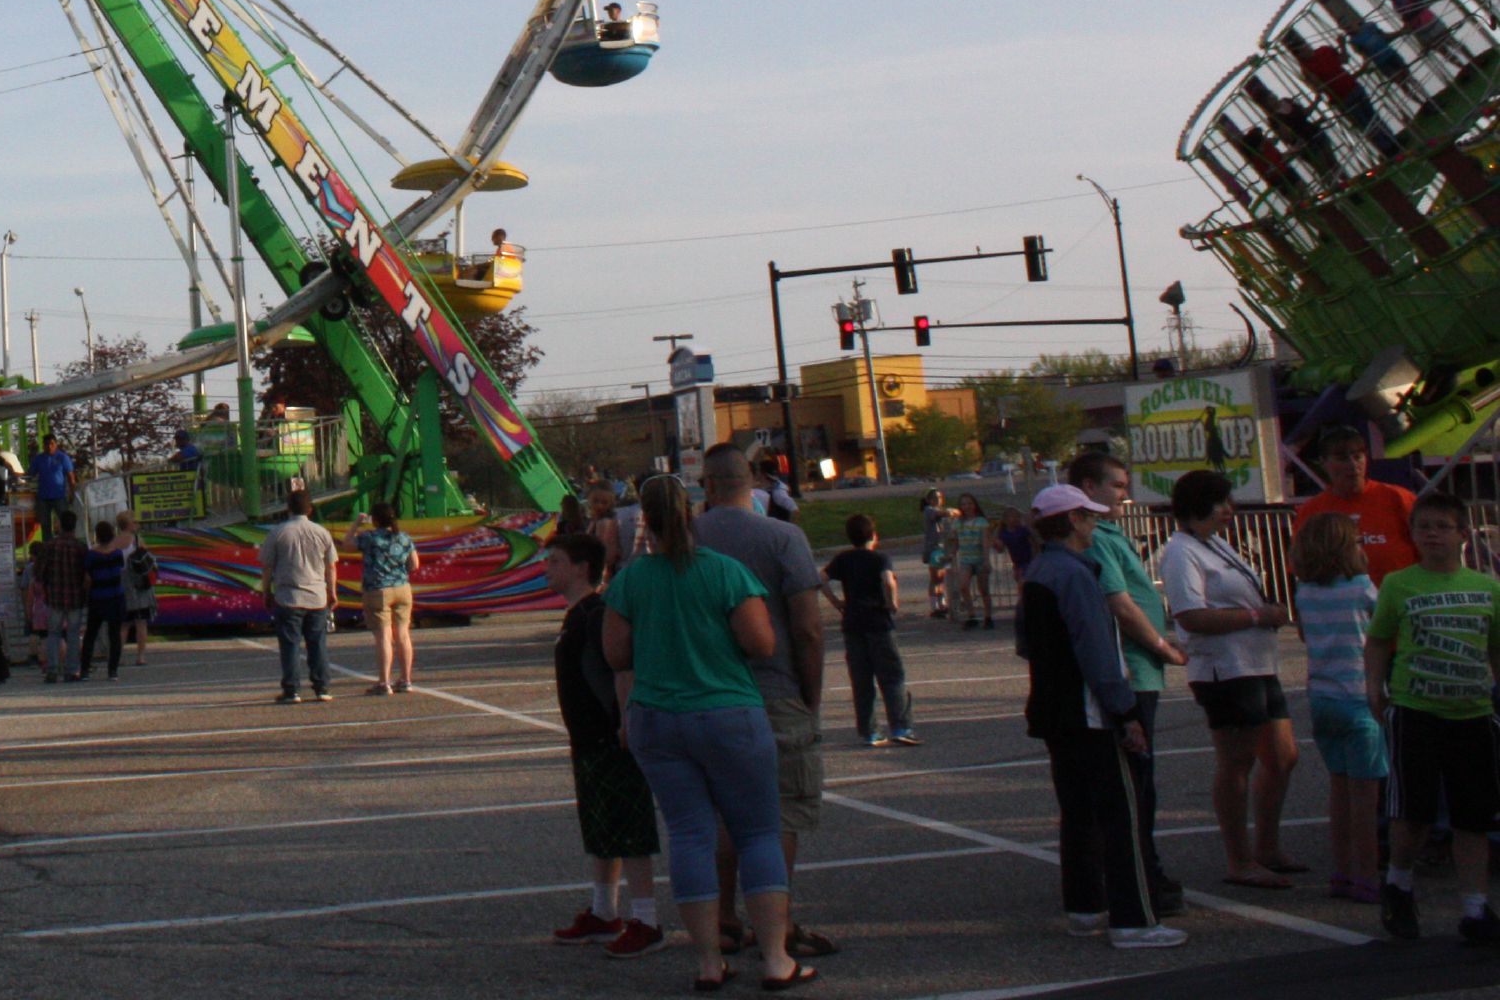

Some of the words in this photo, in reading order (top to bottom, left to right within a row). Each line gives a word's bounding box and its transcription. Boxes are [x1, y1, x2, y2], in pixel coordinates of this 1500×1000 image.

[1140, 377, 1238, 421] ROCKWELL
[1129, 420, 1207, 464] ROUND
[1217, 415, 1255, 460] UP
[1410, 593, 1443, 610] PINCH
[1444, 592, 1467, 606] FREE
